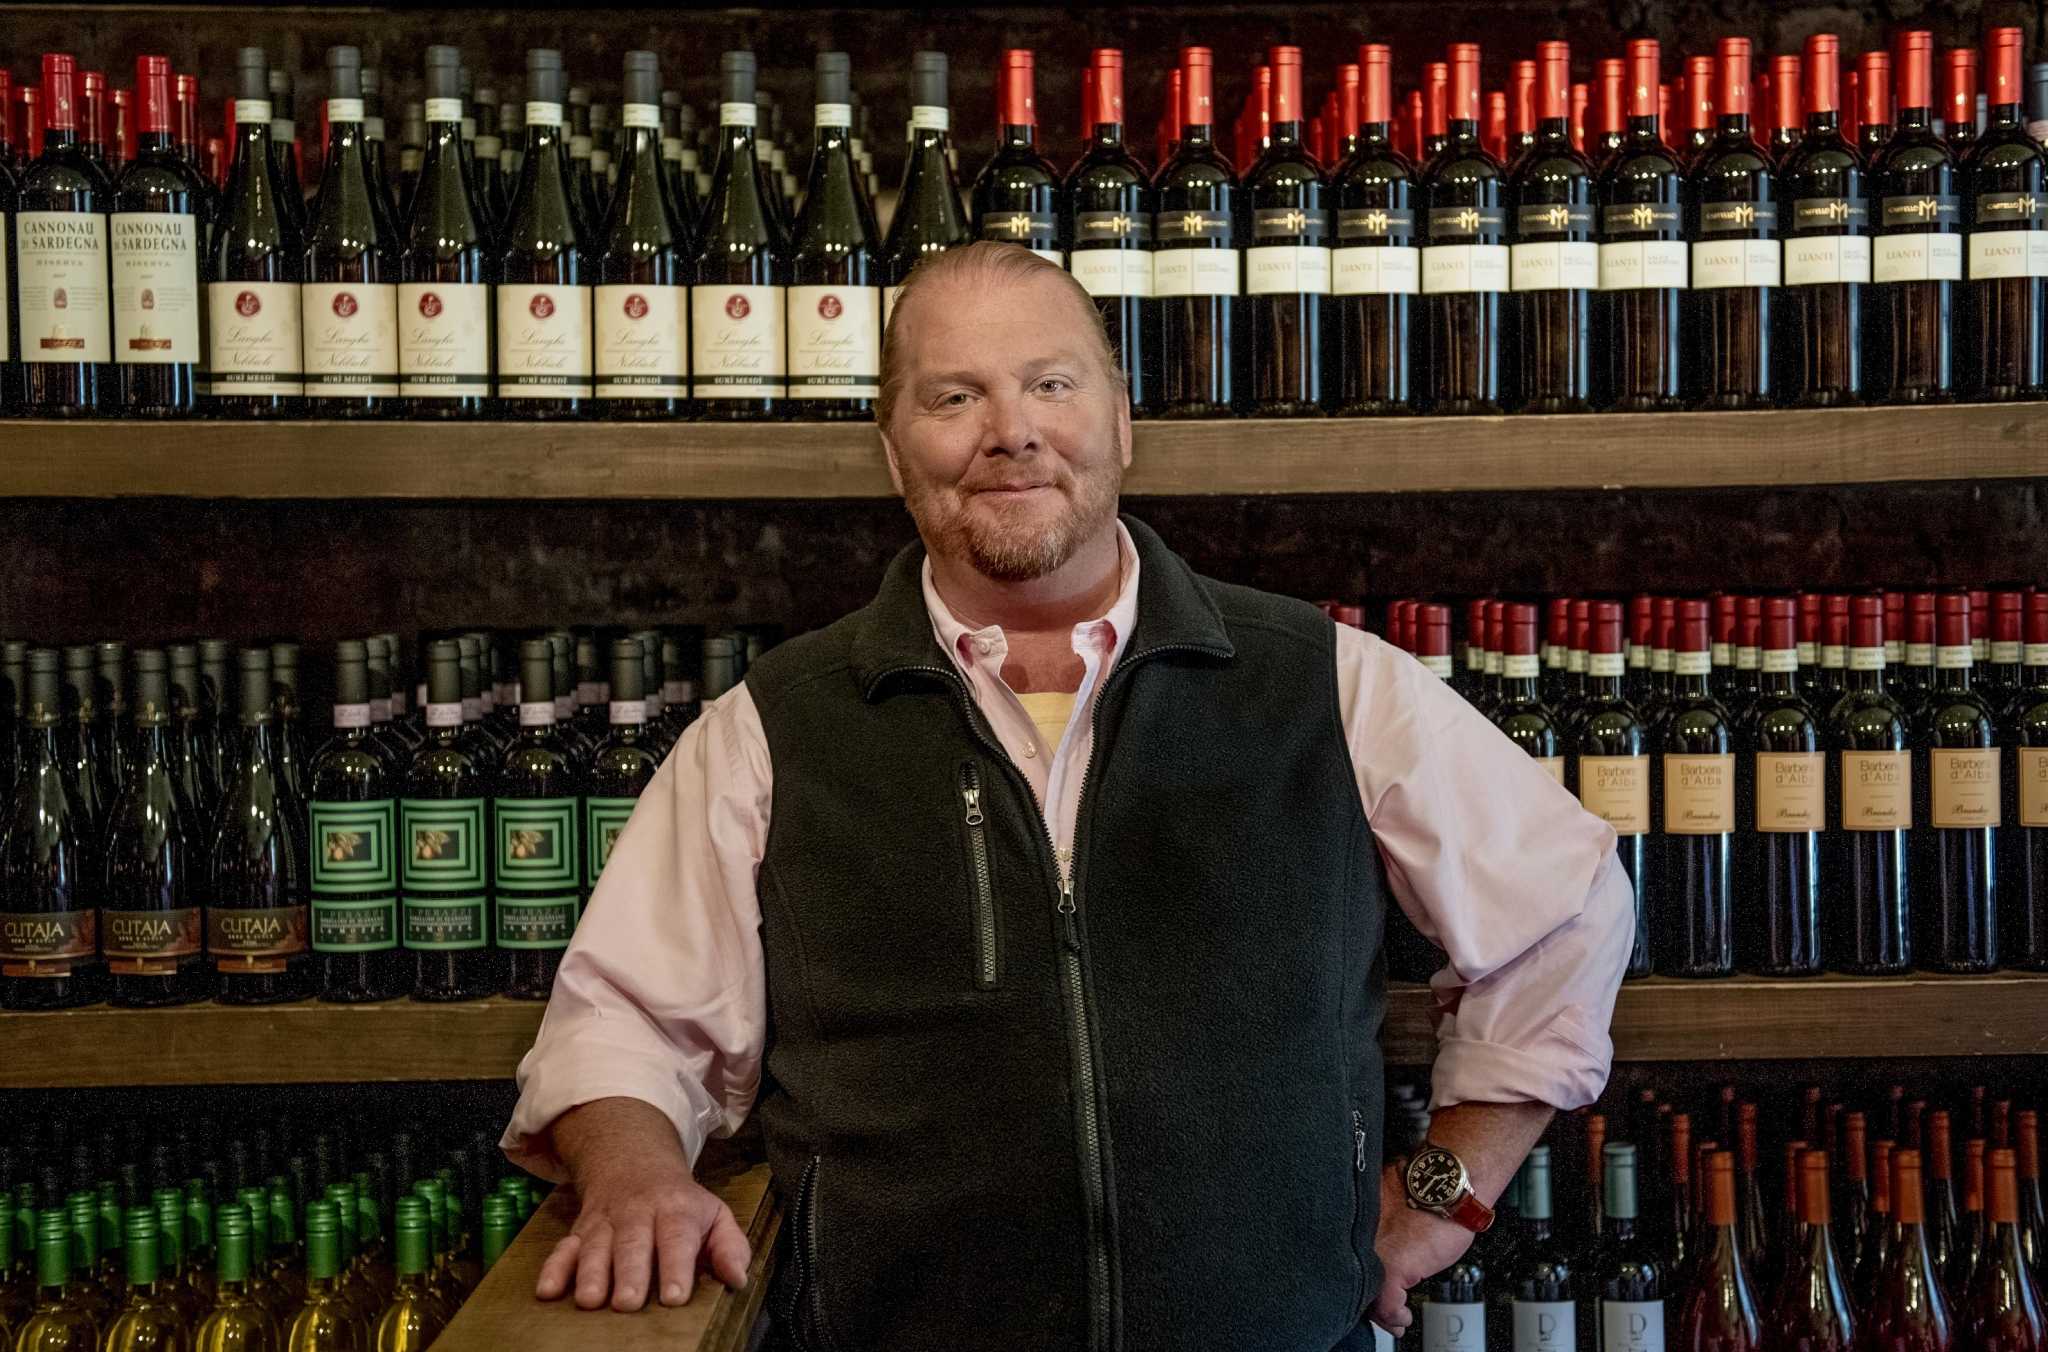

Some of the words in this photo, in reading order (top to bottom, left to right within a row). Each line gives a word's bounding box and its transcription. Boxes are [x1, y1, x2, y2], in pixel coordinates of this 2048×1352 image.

[24, 222, 94, 235] CANNONAU
[115, 223, 181, 236] CANNONAU
[32, 237, 98, 249] SARDEGNA
[122, 238, 187, 250] SARDEGNA
[1680, 763, 1722, 776] Barbera
[4, 922, 64, 939] CUTAJA
[112, 919, 172, 937] CUTAJA
[221, 917, 280, 936] CUTAJA
[1428, 1156, 1435, 1164] 7
[1413, 1171, 1422, 1179] 5
[1413, 1180, 1420, 1189] 4
[1444, 1186, 1455, 1197] 12
[1425, 1194, 1434, 1202] 2
